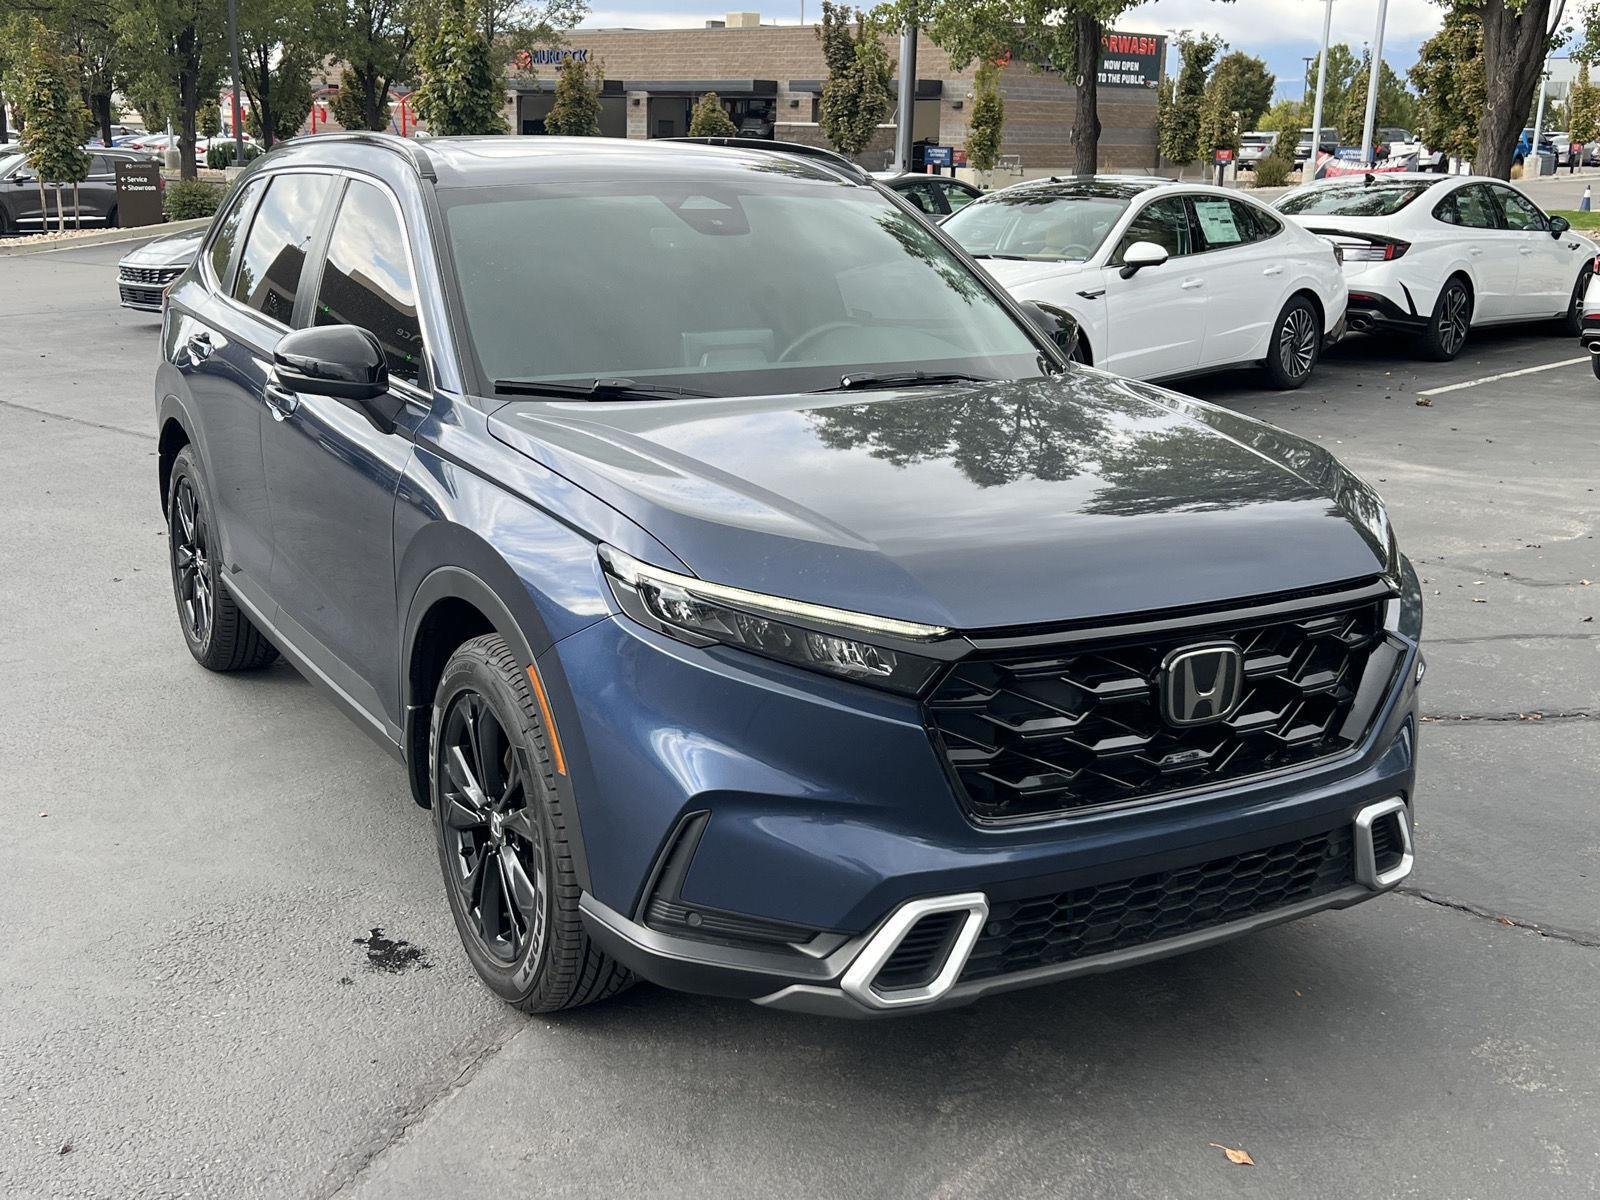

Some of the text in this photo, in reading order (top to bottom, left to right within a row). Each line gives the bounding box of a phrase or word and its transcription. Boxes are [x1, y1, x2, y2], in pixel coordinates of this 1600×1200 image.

[1101, 35, 1156, 55] RWASH
[1103, 60, 1139, 71] NOW OPEN
[1098, 73, 1145, 84] TO THE PUBLIC
